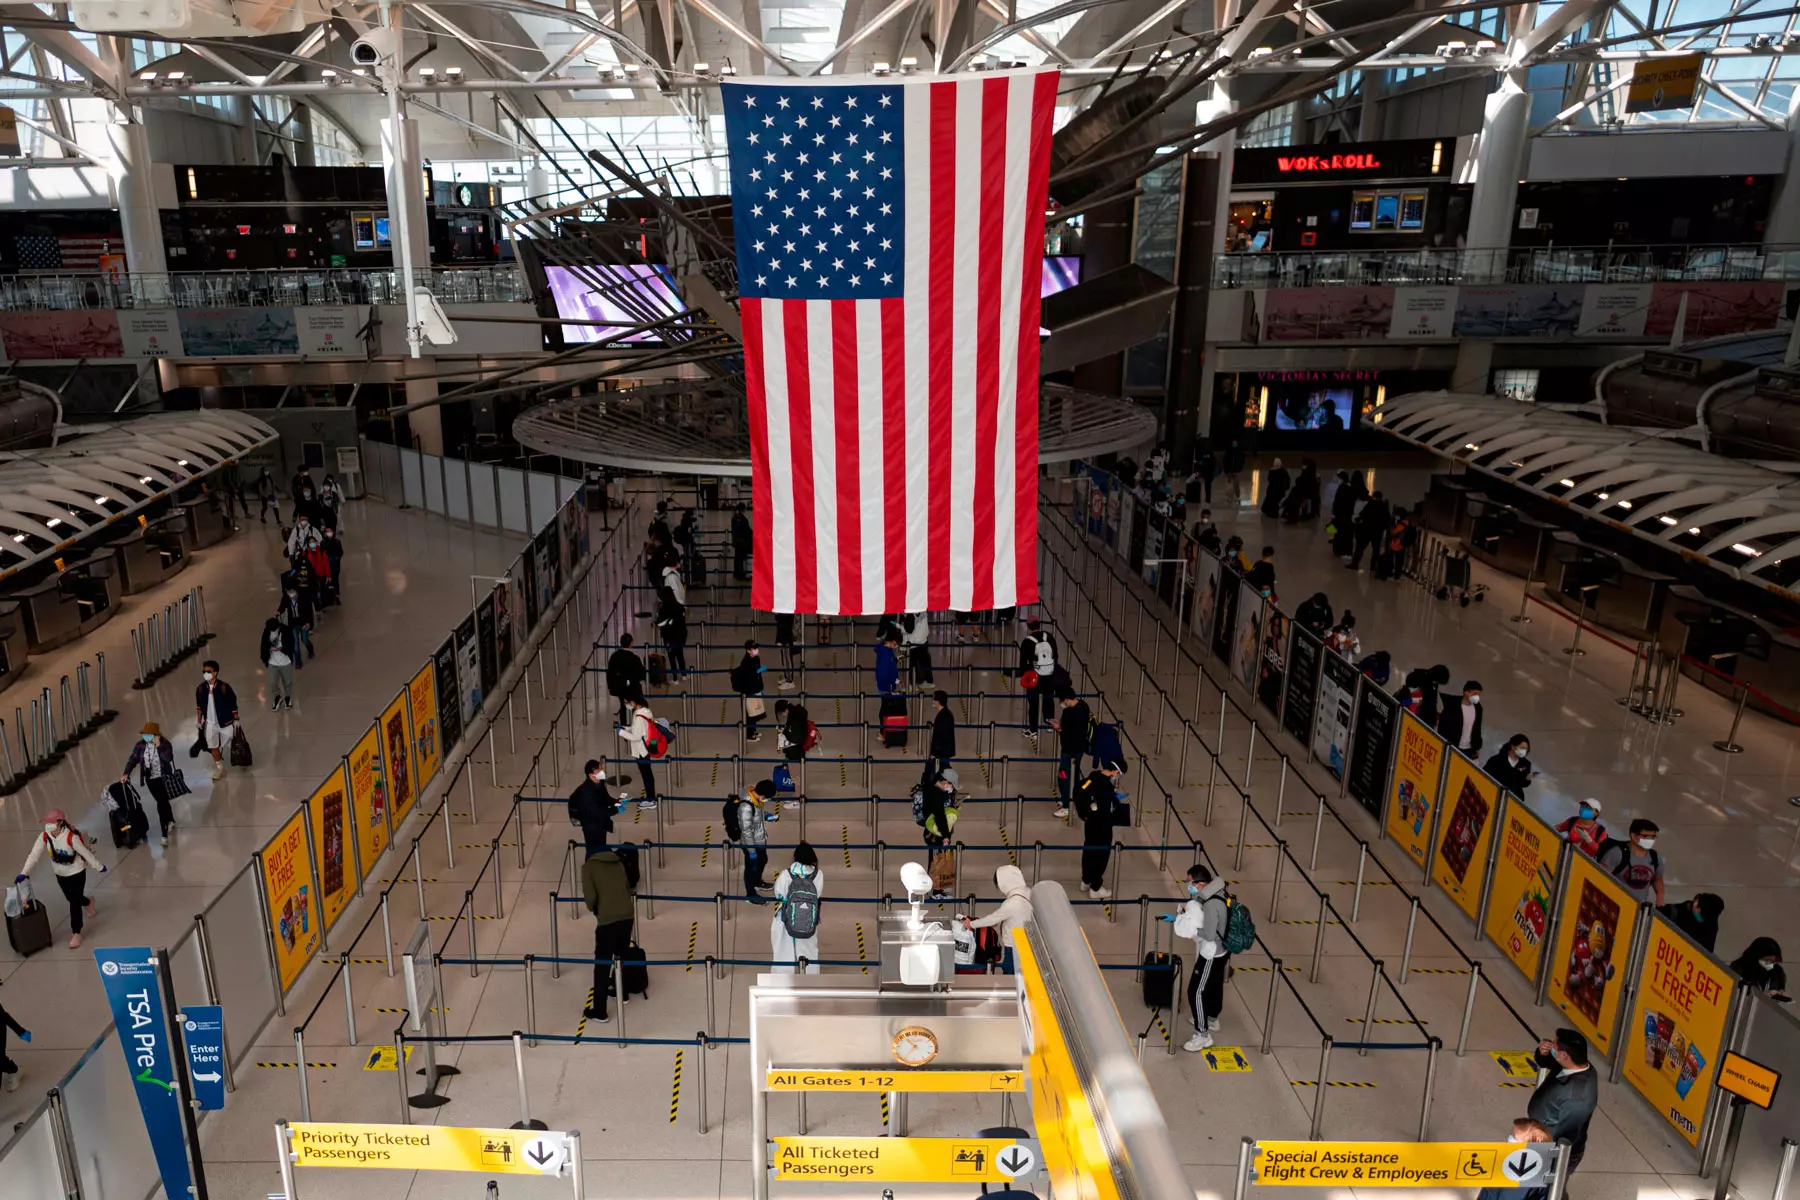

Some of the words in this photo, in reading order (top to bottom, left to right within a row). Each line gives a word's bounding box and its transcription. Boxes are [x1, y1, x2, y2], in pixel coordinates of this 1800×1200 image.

[1277, 155, 1319, 172] WOK
[1333, 370, 1380, 381] SECRET
[1405, 728, 1418, 749] BUY
[1419, 738, 1424, 753] 3
[1424, 740, 1439, 764] GET
[1408, 750, 1425, 775] FREE
[1511, 816, 1525, 838] NOW
[1524, 828, 1541, 849] WITH
[268, 847, 282, 877] BUY
[288, 826, 301, 854] GET
[1507, 831, 1540, 867] EXCLUSIVE
[277, 857, 295, 890] FREE
[1513, 853, 1536, 880] SLEEVE
[1657, 937, 1684, 974] BUY
[1684, 960, 1694, 984] 3
[1695, 970, 1723, 1006] GET
[1653, 962, 1660, 983] 1
[1662, 970, 1696, 1014] FREE
[126, 988, 153, 1030] TSA
[132, 1033, 156, 1068] Pre
[190, 1044, 220, 1054] Enter
[193, 1053, 220, 1063] Here
[773, 1075, 797, 1085] All
[802, 1076, 852, 1086] Gates
[858, 1077, 894, 1086] 1-12
[1725, 1067, 1746, 1083] WHEEL
[1747, 1078, 1771, 1094] CHAIRS
[301, 1131, 359, 1147] Priority
[363, 1132, 430, 1146] Ticketed
[303, 1146, 391, 1162] Passengers
[782, 1146, 804, 1158] All
[809, 1146, 879, 1159] Ticketed
[1265, 1150, 1318, 1165] Special
[1321, 1151, 1399, 1164] Assistance
[782, 1162, 874, 1178] Passengers
[1263, 1165, 1306, 1181] Flight
[1309, 1166, 1349, 1179] Crew
[1352, 1167, 1364, 1179] &
[1368, 1166, 1449, 1183] Employees
